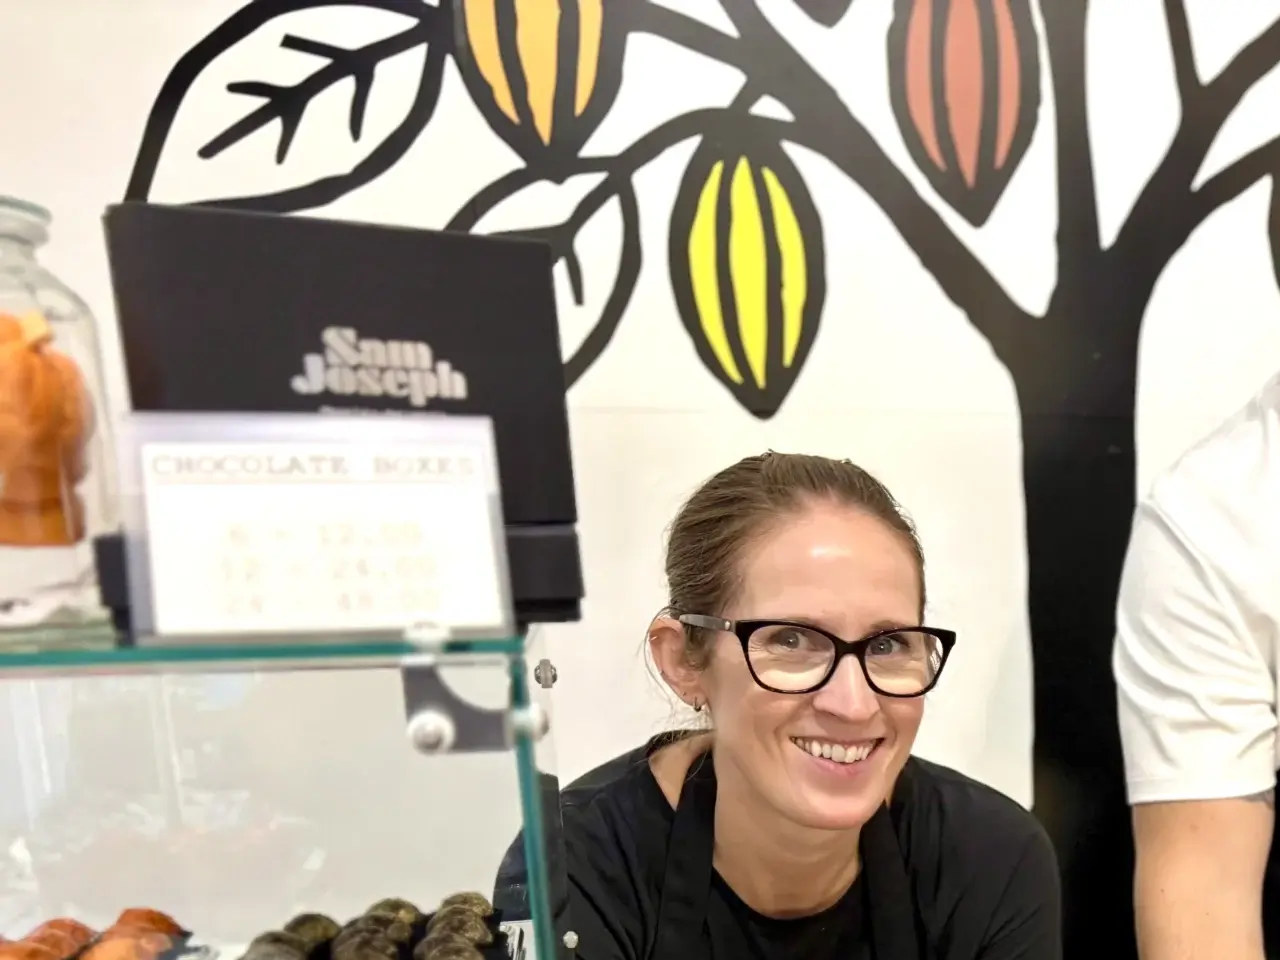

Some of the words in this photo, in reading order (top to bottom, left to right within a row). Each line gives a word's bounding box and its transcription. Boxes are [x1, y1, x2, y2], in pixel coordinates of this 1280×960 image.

[321, 325, 433, 369] Sam
[290, 354, 468, 407] Joseph
[151, 454, 349, 476] CHOCOLATE
[373, 455, 475, 476] BOXES
